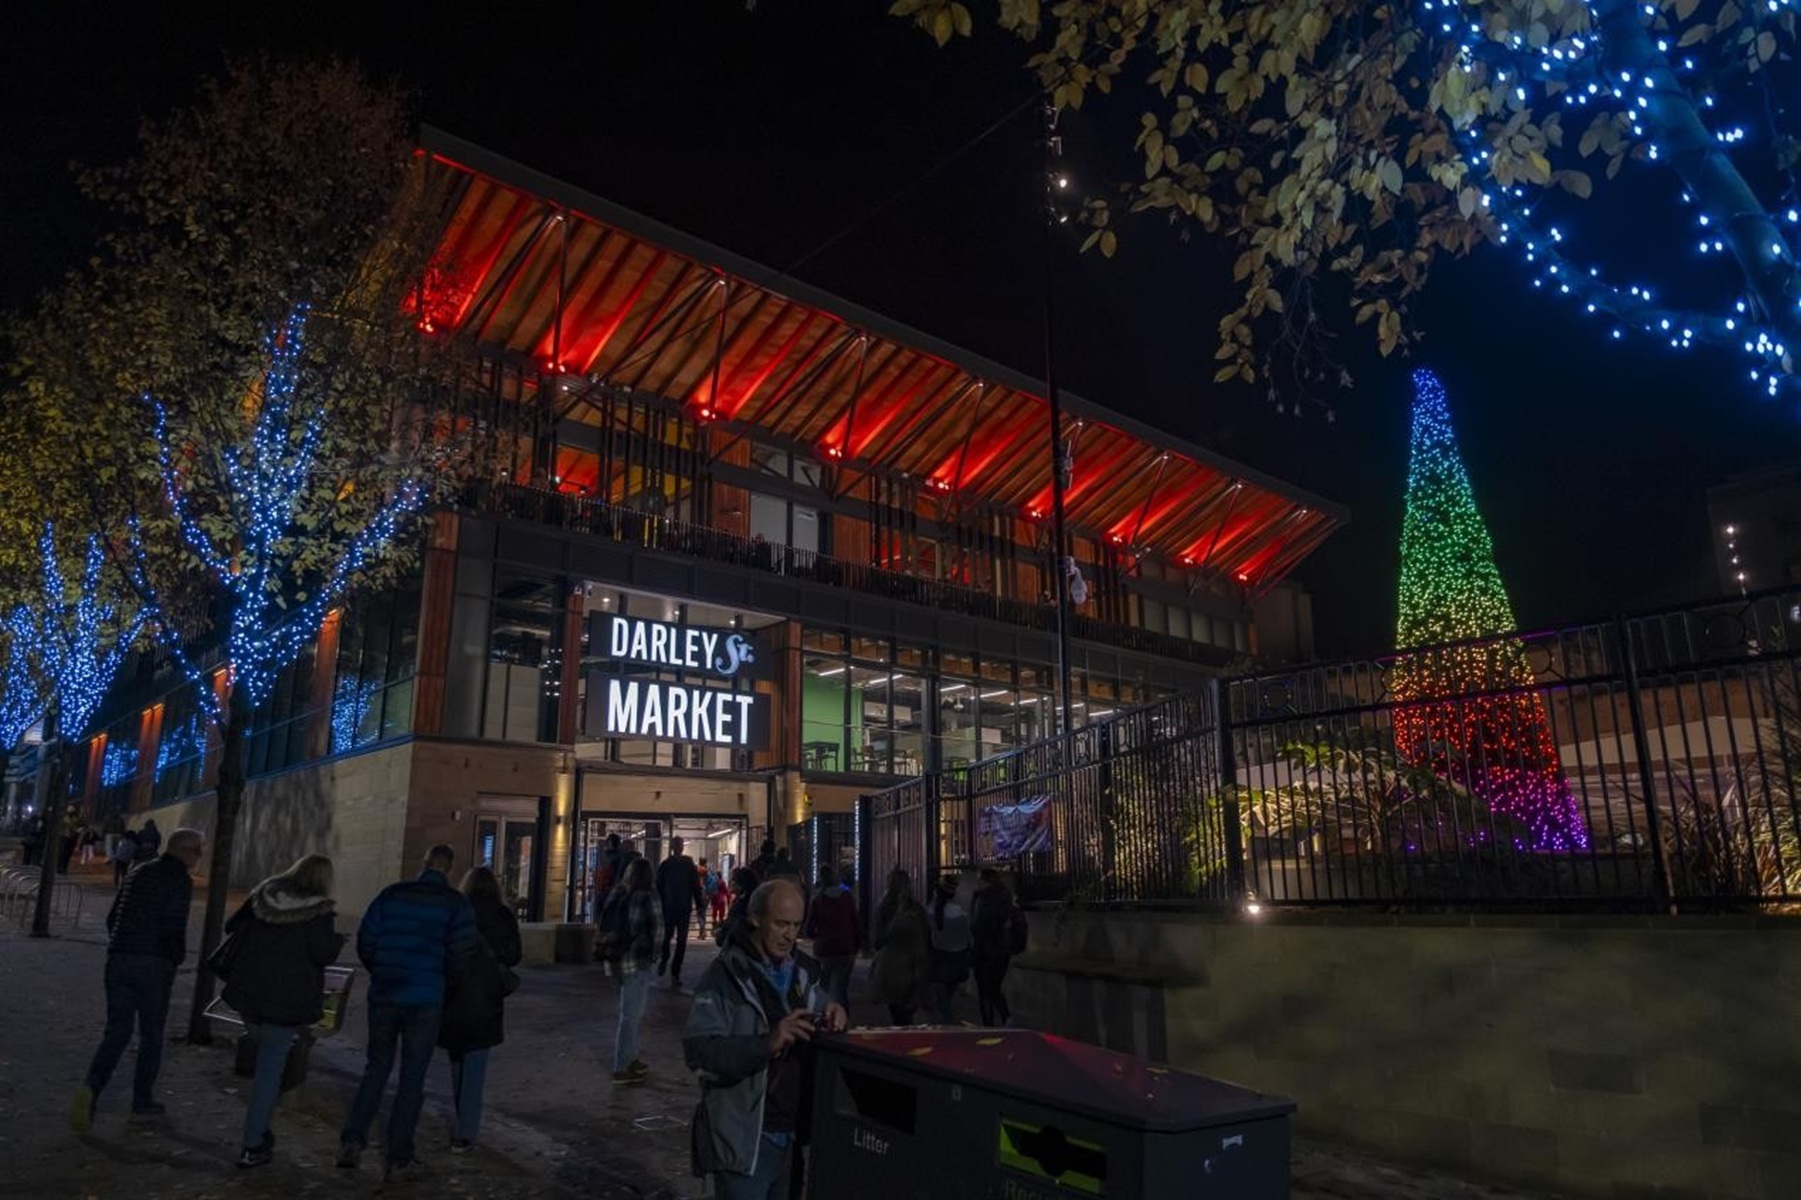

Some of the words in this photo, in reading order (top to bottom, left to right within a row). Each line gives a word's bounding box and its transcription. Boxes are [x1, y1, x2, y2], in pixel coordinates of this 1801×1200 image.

[611, 617, 718, 669] DARLEY
[607, 679, 754, 744] MARKET
[854, 1127, 890, 1155] Litter
